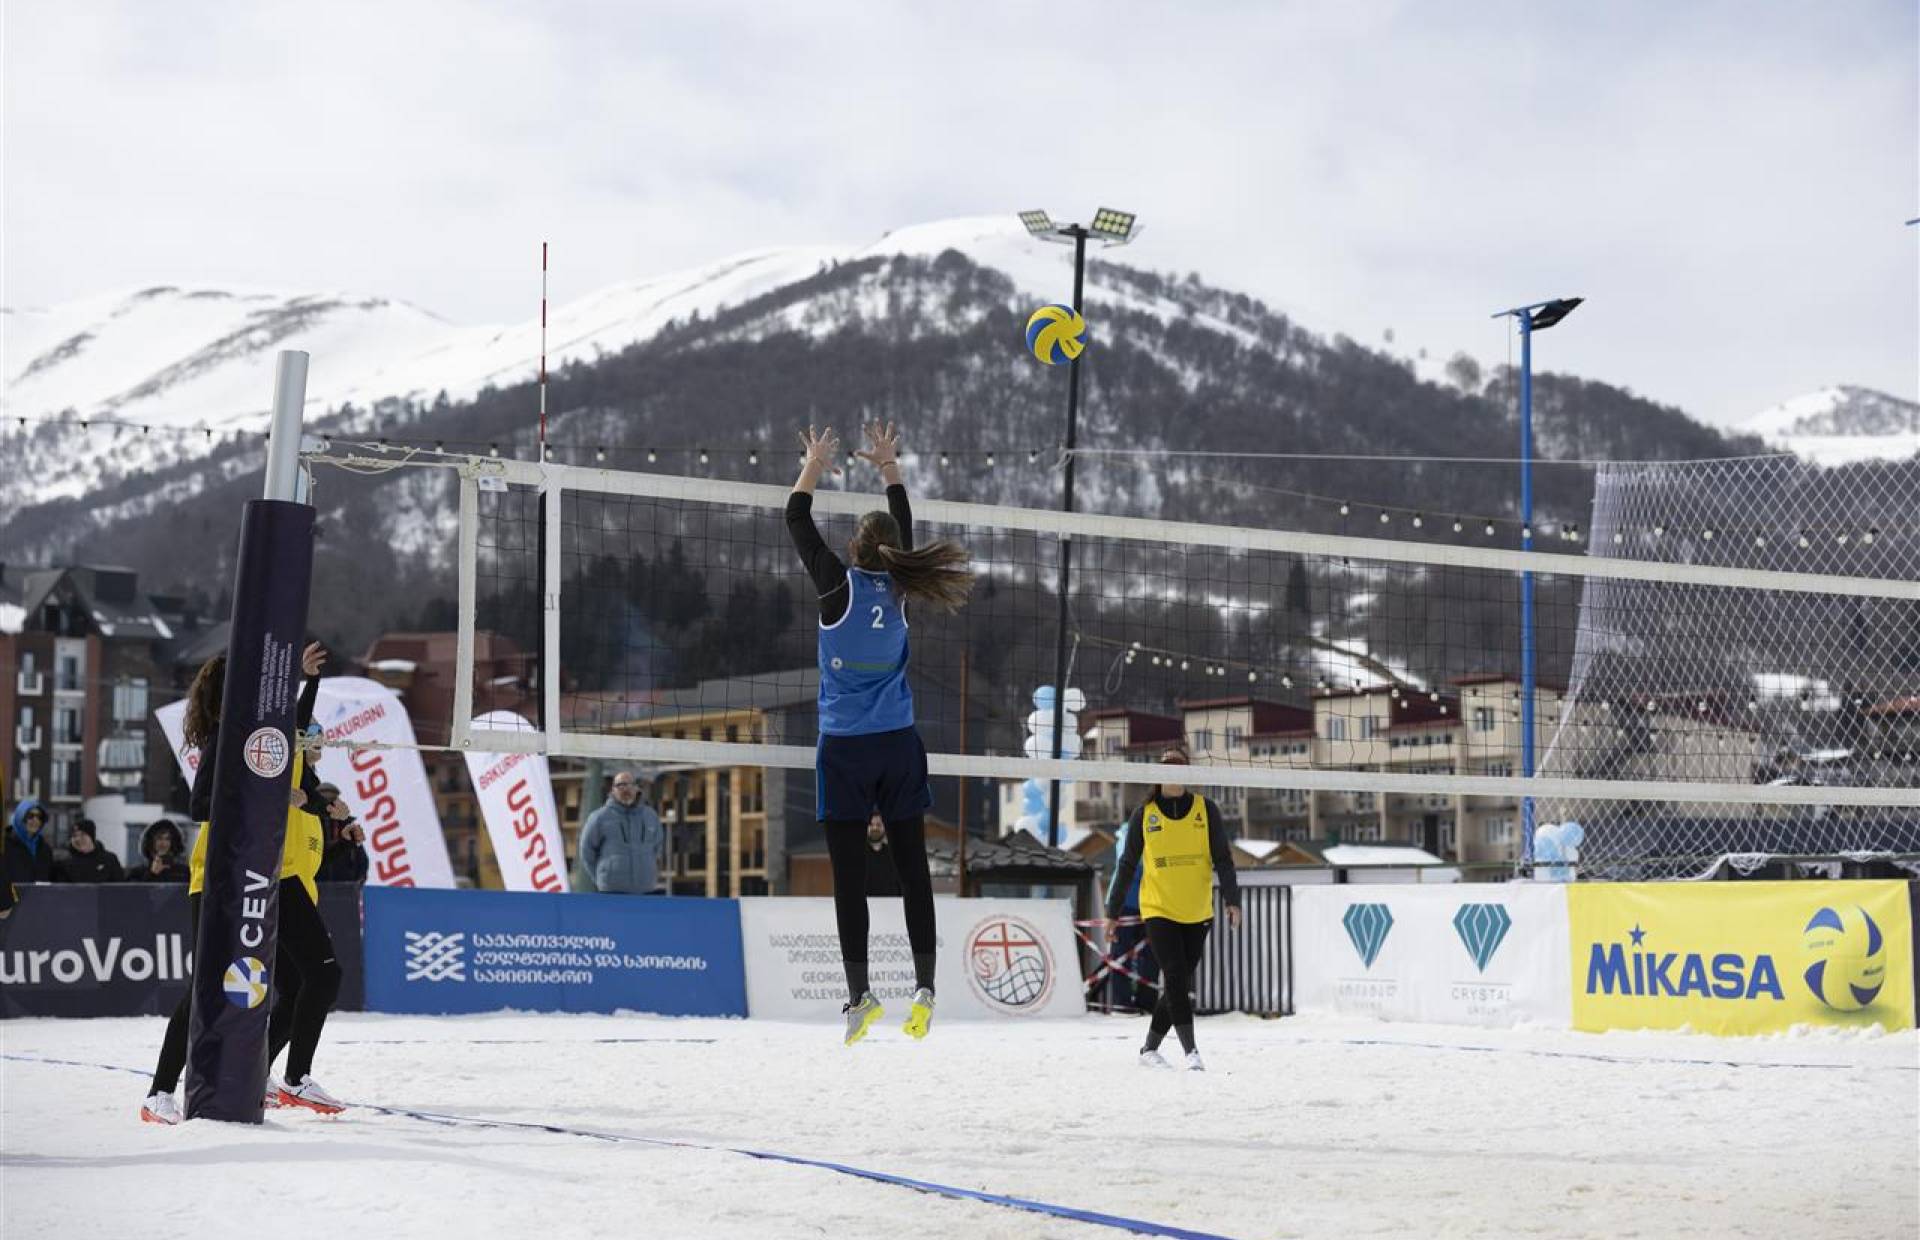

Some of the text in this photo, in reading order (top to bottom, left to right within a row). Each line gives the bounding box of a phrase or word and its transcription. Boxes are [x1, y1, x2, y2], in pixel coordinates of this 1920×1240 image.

[871, 605, 885, 629] 2
[240, 869, 270, 948] CEV
[0, 933, 193, 985] uroVoll
